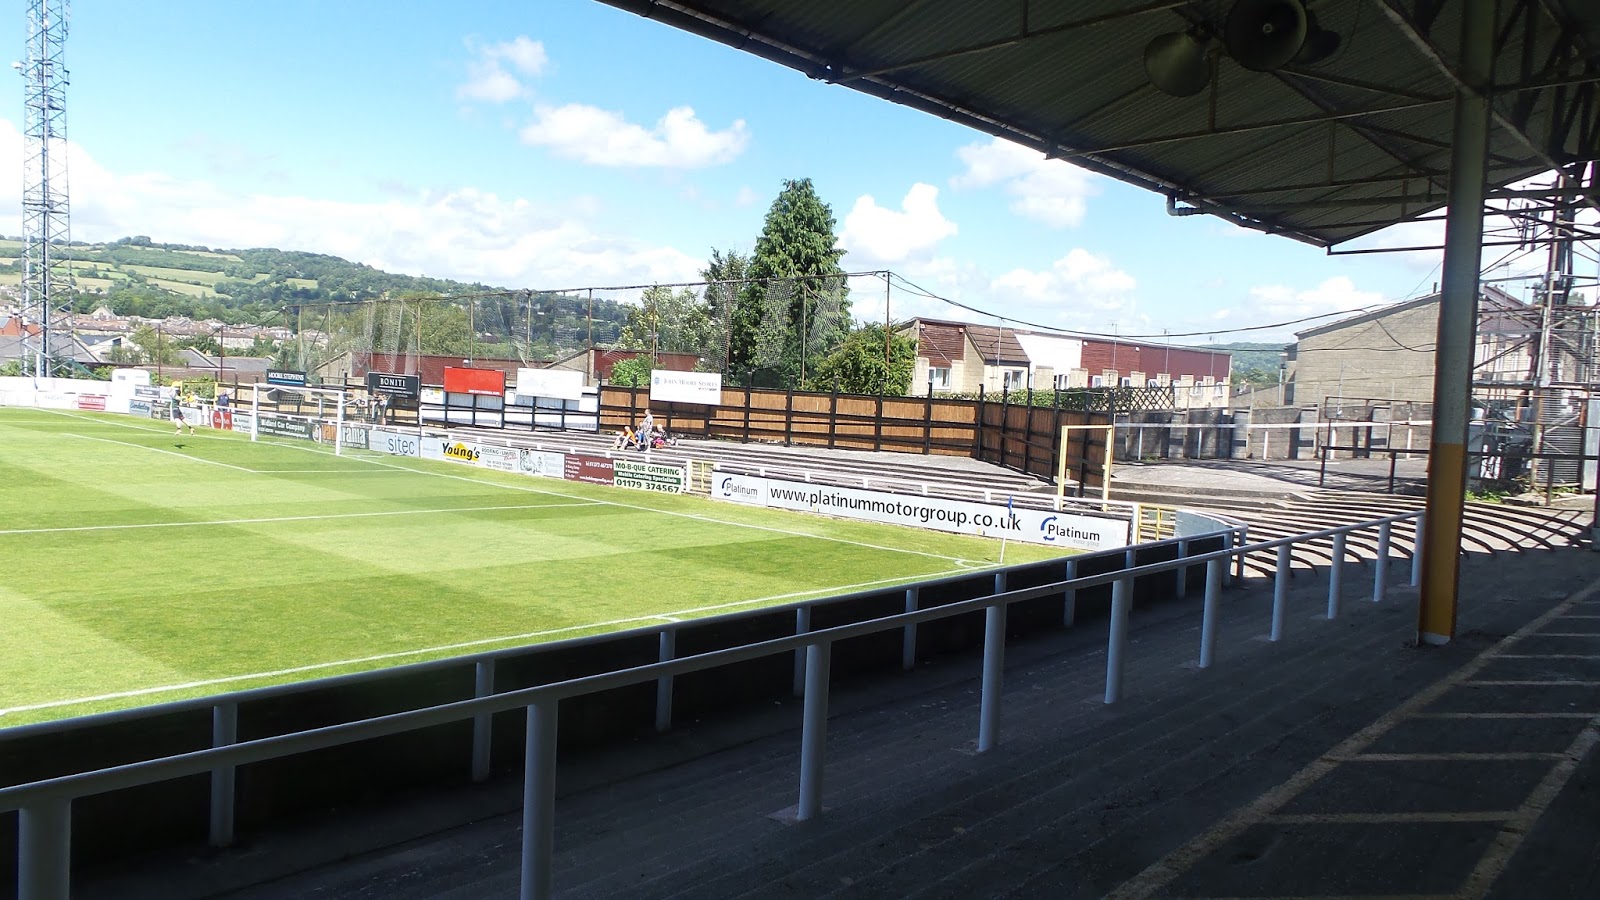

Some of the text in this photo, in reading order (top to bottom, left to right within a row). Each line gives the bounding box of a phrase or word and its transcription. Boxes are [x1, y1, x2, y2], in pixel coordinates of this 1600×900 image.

[388, 434, 415, 455] sitec
[442, 442, 480, 460] Young's
[647, 465, 680, 476] CATERING
[616, 478, 642, 489] 01179
[645, 482, 680, 493] 374567
[726, 482, 758, 496] Platinum
[770, 487, 1021, 531] www.platinummotorgroup.co.uk
[1047, 523, 1100, 542] Platinum
